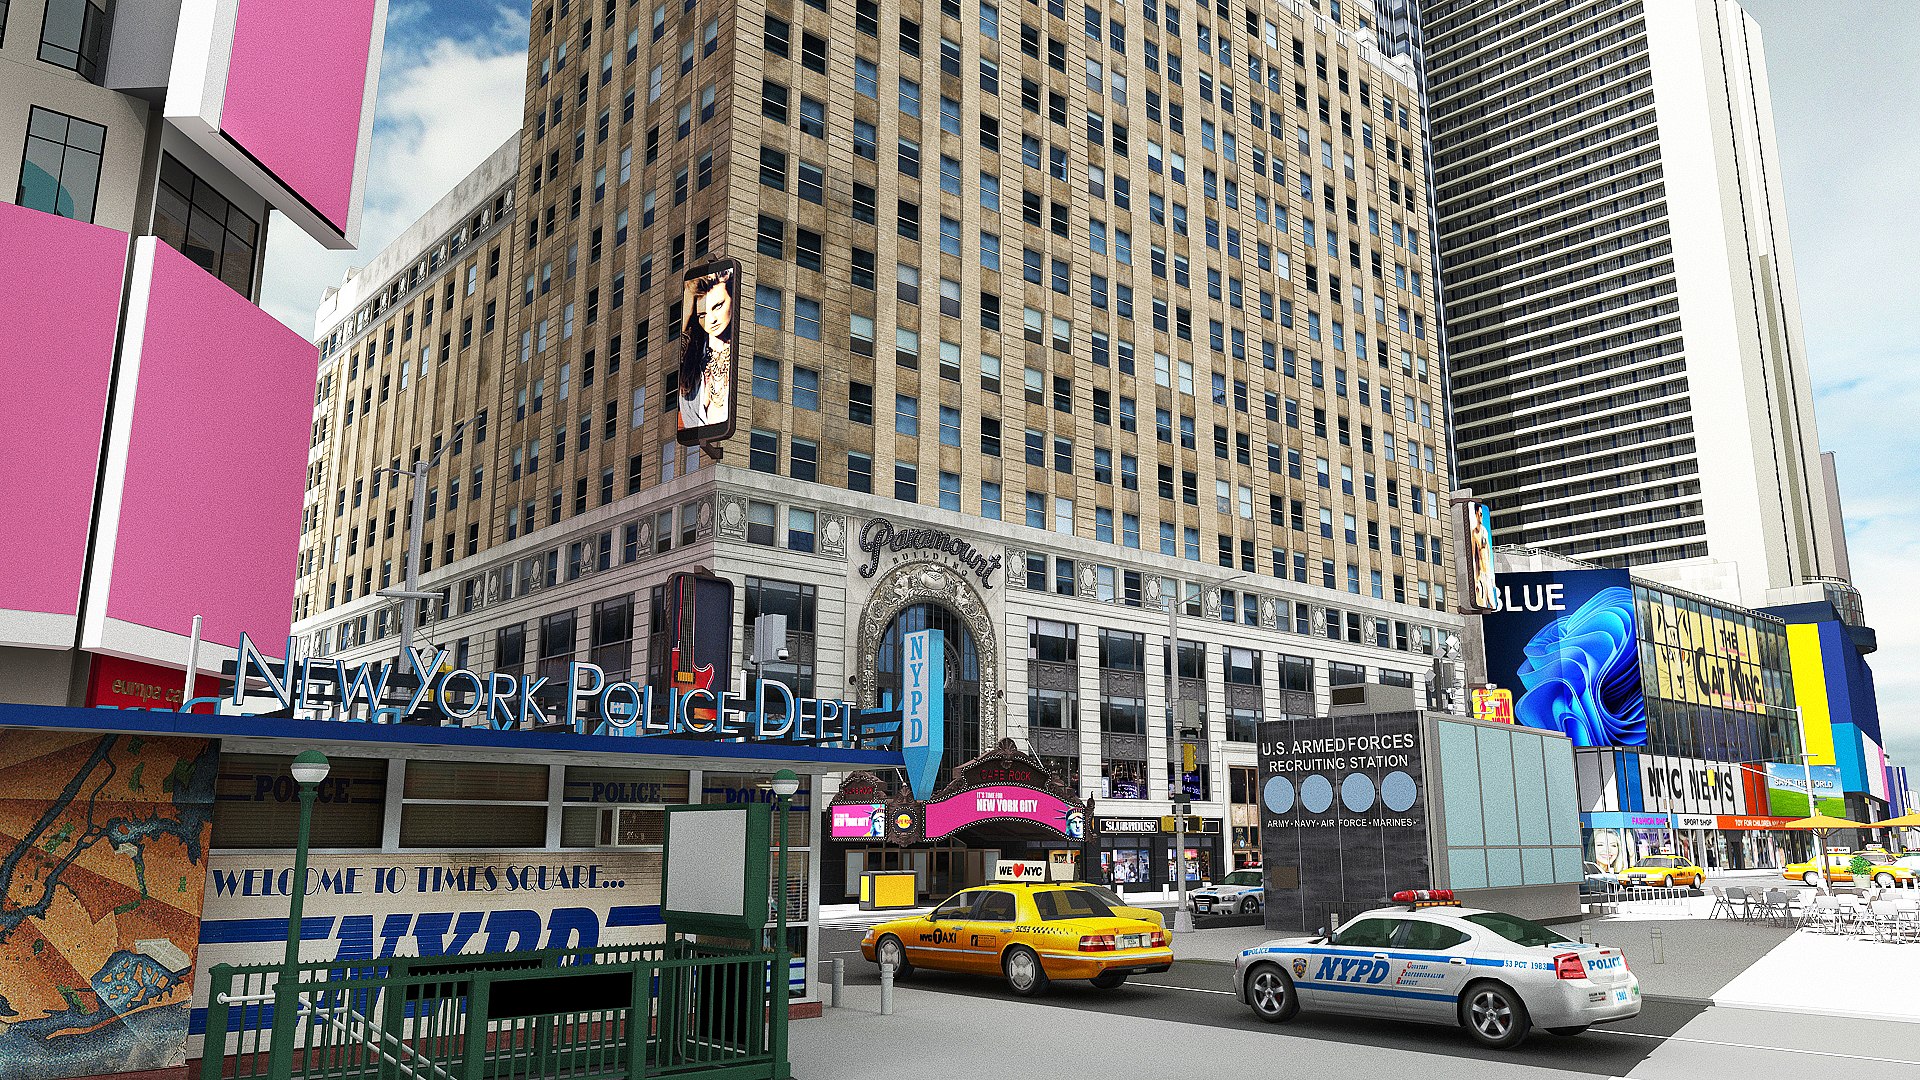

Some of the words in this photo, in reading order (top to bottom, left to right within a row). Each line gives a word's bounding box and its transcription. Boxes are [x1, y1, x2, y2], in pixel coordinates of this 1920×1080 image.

[859, 517, 1002, 589] Paramount
[892, 551, 968, 577] BUILDING
[1720, 630, 1736, 648] THE
[233, 631, 393, 712] NEW
[404, 645, 549, 723] YORK
[565, 661, 740, 735] POLICE
[910, 636, 923, 743] NYPD
[1262, 741, 1289, 755] U.S.
[1291, 737, 1345, 754] ARMED
[1348, 734, 1414, 751] FORCES
[1270, 758, 1346, 772] RECRUITING
[1350, 754, 1408, 768] STATION
[1008, 769, 1030, 781] ROCK
[1814, 780, 1833, 788] ORLD
[591, 782, 661, 803] POLICE
[977, 799, 995, 812] NEW
[997, 799, 1019, 812] YORK
[1019, 800, 1038, 813] CITY
[1267, 820, 1290, 828] ARMY
[1294, 819, 1316, 828] NAVY
[1321, 819, 1335, 828] AIR
[1339, 819, 1367, 827] FORCE
[1372, 818, 1413, 827] MARINES
[1684, 818, 1699, 826] SPORT
[1700, 818, 1712, 826] SHOP
[999, 865, 1013, 876] WE
[1024, 866, 1043, 876] NYC
[212, 867, 364, 898] WELCOME
[371, 867, 407, 894] TO
[415, 866, 498, 893] TIMES
[1248, 947, 1269, 956] POLICE
[1314, 956, 1390, 984] NYPD
[1505, 960, 1513, 968] 53
[1514, 961, 1527, 969] PCT
[1531, 961, 1547, 970] 1983
[1588, 956, 1621, 971] POLICE
